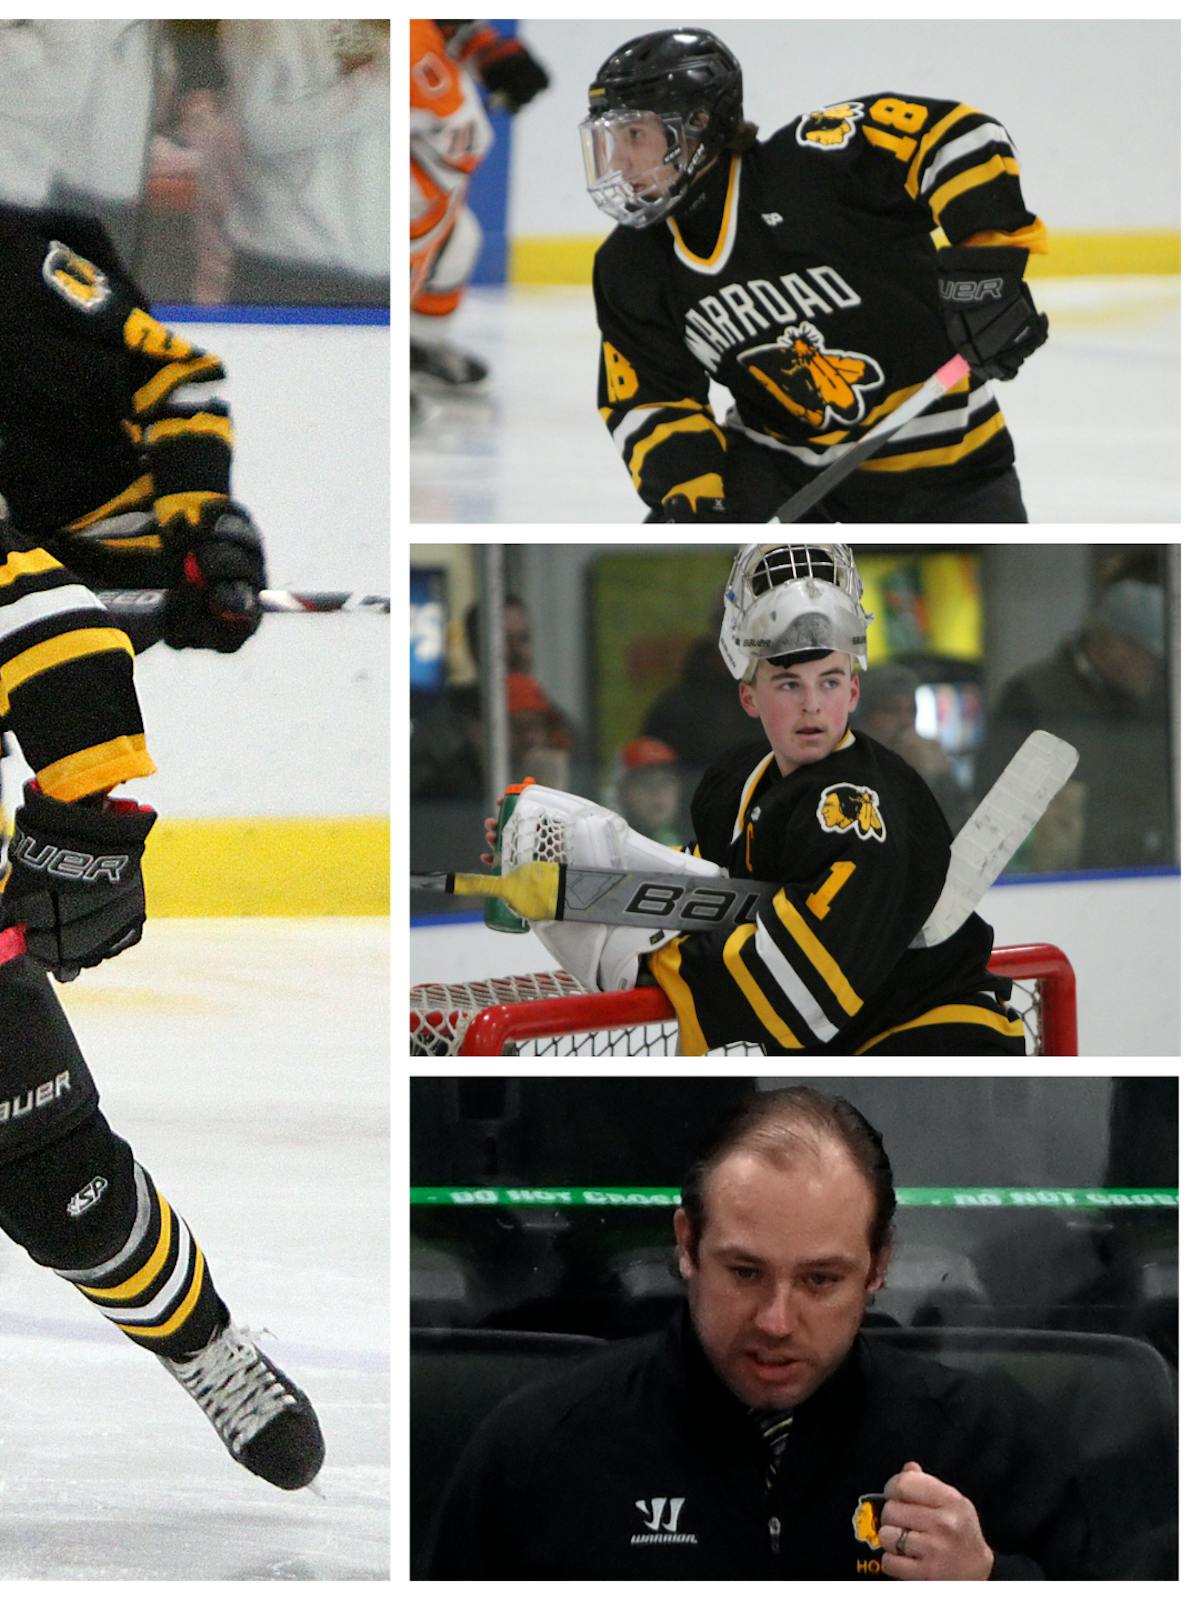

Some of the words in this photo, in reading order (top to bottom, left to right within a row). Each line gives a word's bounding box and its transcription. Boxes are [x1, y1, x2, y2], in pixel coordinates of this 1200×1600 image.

[862, 97, 929, 164] 18
[684, 265, 862, 373] WARROAD
[13, 834, 130, 882] UER
[806, 861, 857, 921] 1
[1086, 1192, 1179, 1206] CROS
